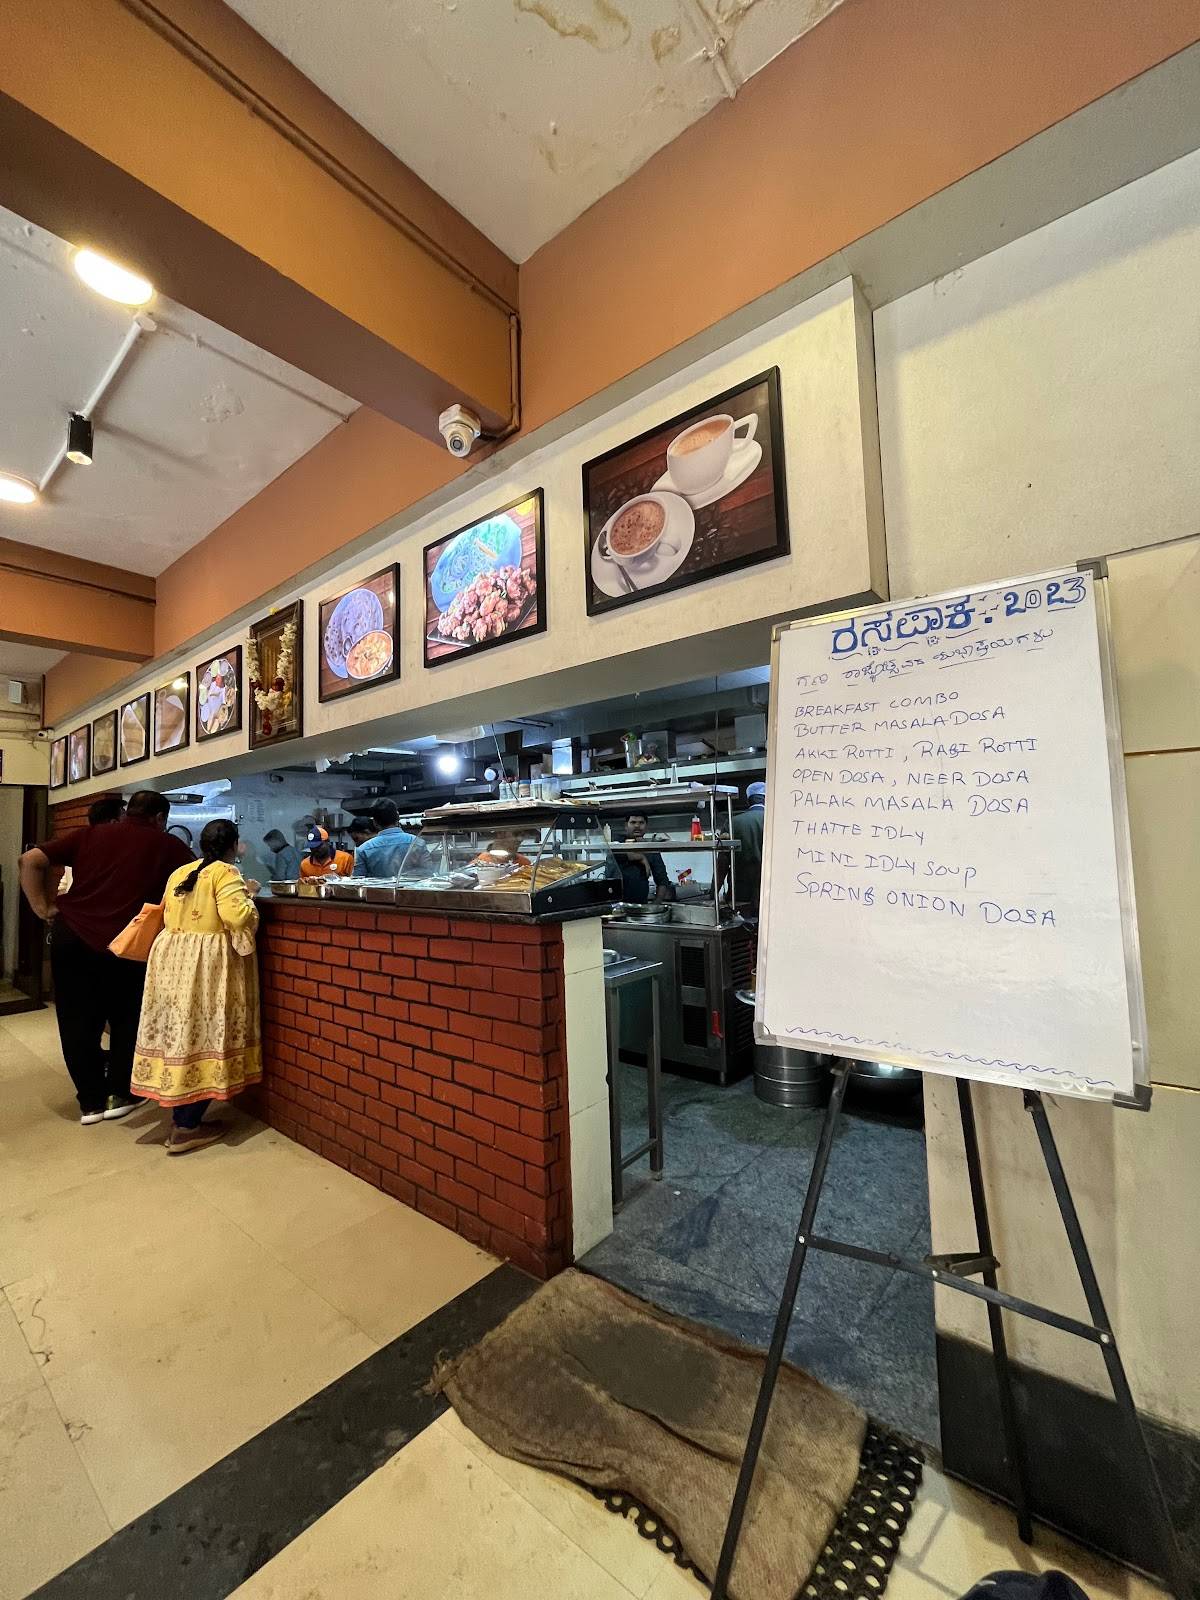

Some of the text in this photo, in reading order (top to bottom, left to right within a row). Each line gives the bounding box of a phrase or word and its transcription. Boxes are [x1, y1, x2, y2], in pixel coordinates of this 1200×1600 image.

[794, 691, 960, 718] BREAKFAST COMBO
[793, 706, 1006, 738] BUTTER MASALA DOSA
[794, 746, 837, 760] AKKI
[978, 737, 1039, 754] ROTTI
[792, 768, 834, 785] OPEN
[907, 772, 967, 786] NEER
[972, 769, 1030, 788] DOSA
[790, 789, 1029, 817] PALAK MASALA DOSA
[792, 820, 925, 846] THATTE IDLY
[797, 847, 977, 888] MINI IDLY SOUP
[886, 889, 966, 918] ONION
[979, 901, 1057, 928] DOSA
